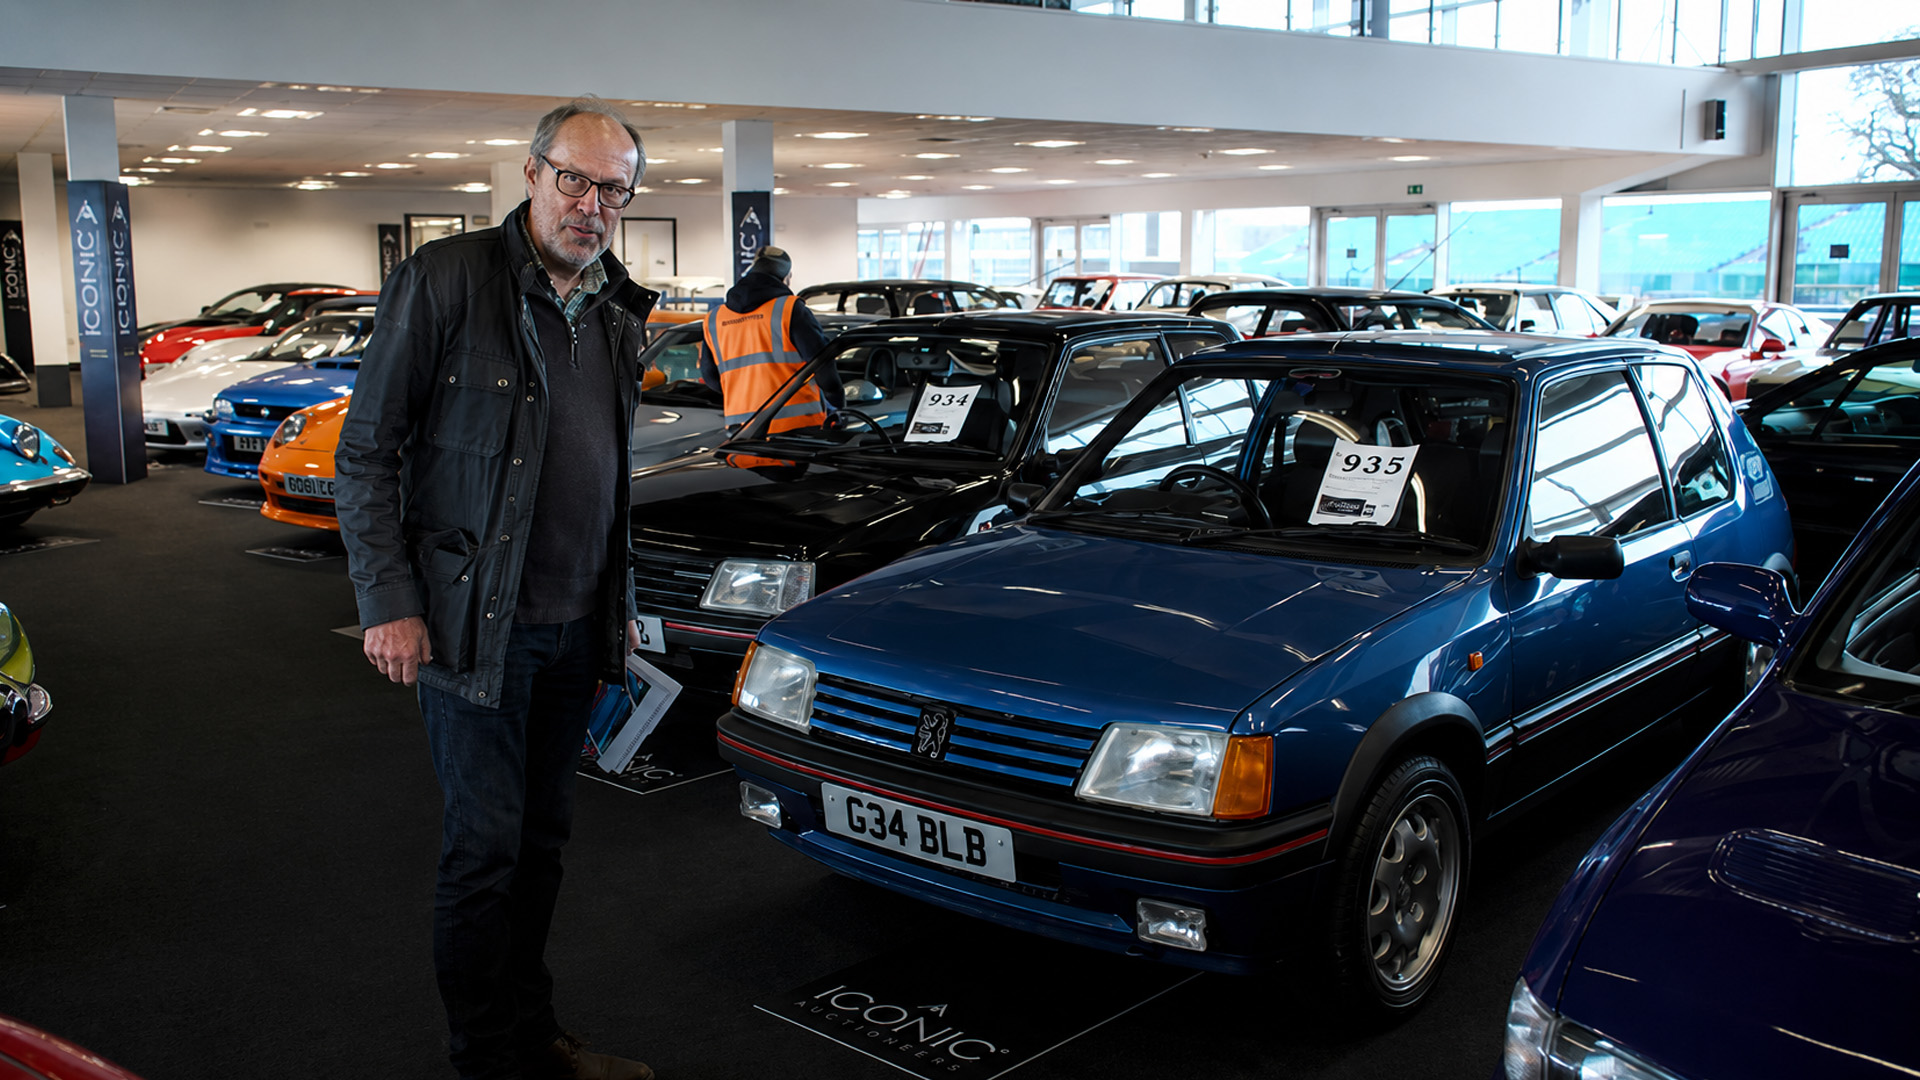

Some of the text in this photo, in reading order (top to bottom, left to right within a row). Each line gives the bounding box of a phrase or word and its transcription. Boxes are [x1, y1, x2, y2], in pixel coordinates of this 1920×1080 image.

[77, 230, 101, 335] ICONIC
[113, 230, 130, 335] ICONIC
[740, 232, 757, 277] NIC
[928, 393, 969, 406] 934
[1342, 454, 1405, 475] 935
[846, 795, 987, 867] G34 BLB
[794, 1000, 960, 1072] AUCTIONEERS
[814, 985, 996, 1060] ICONIC
